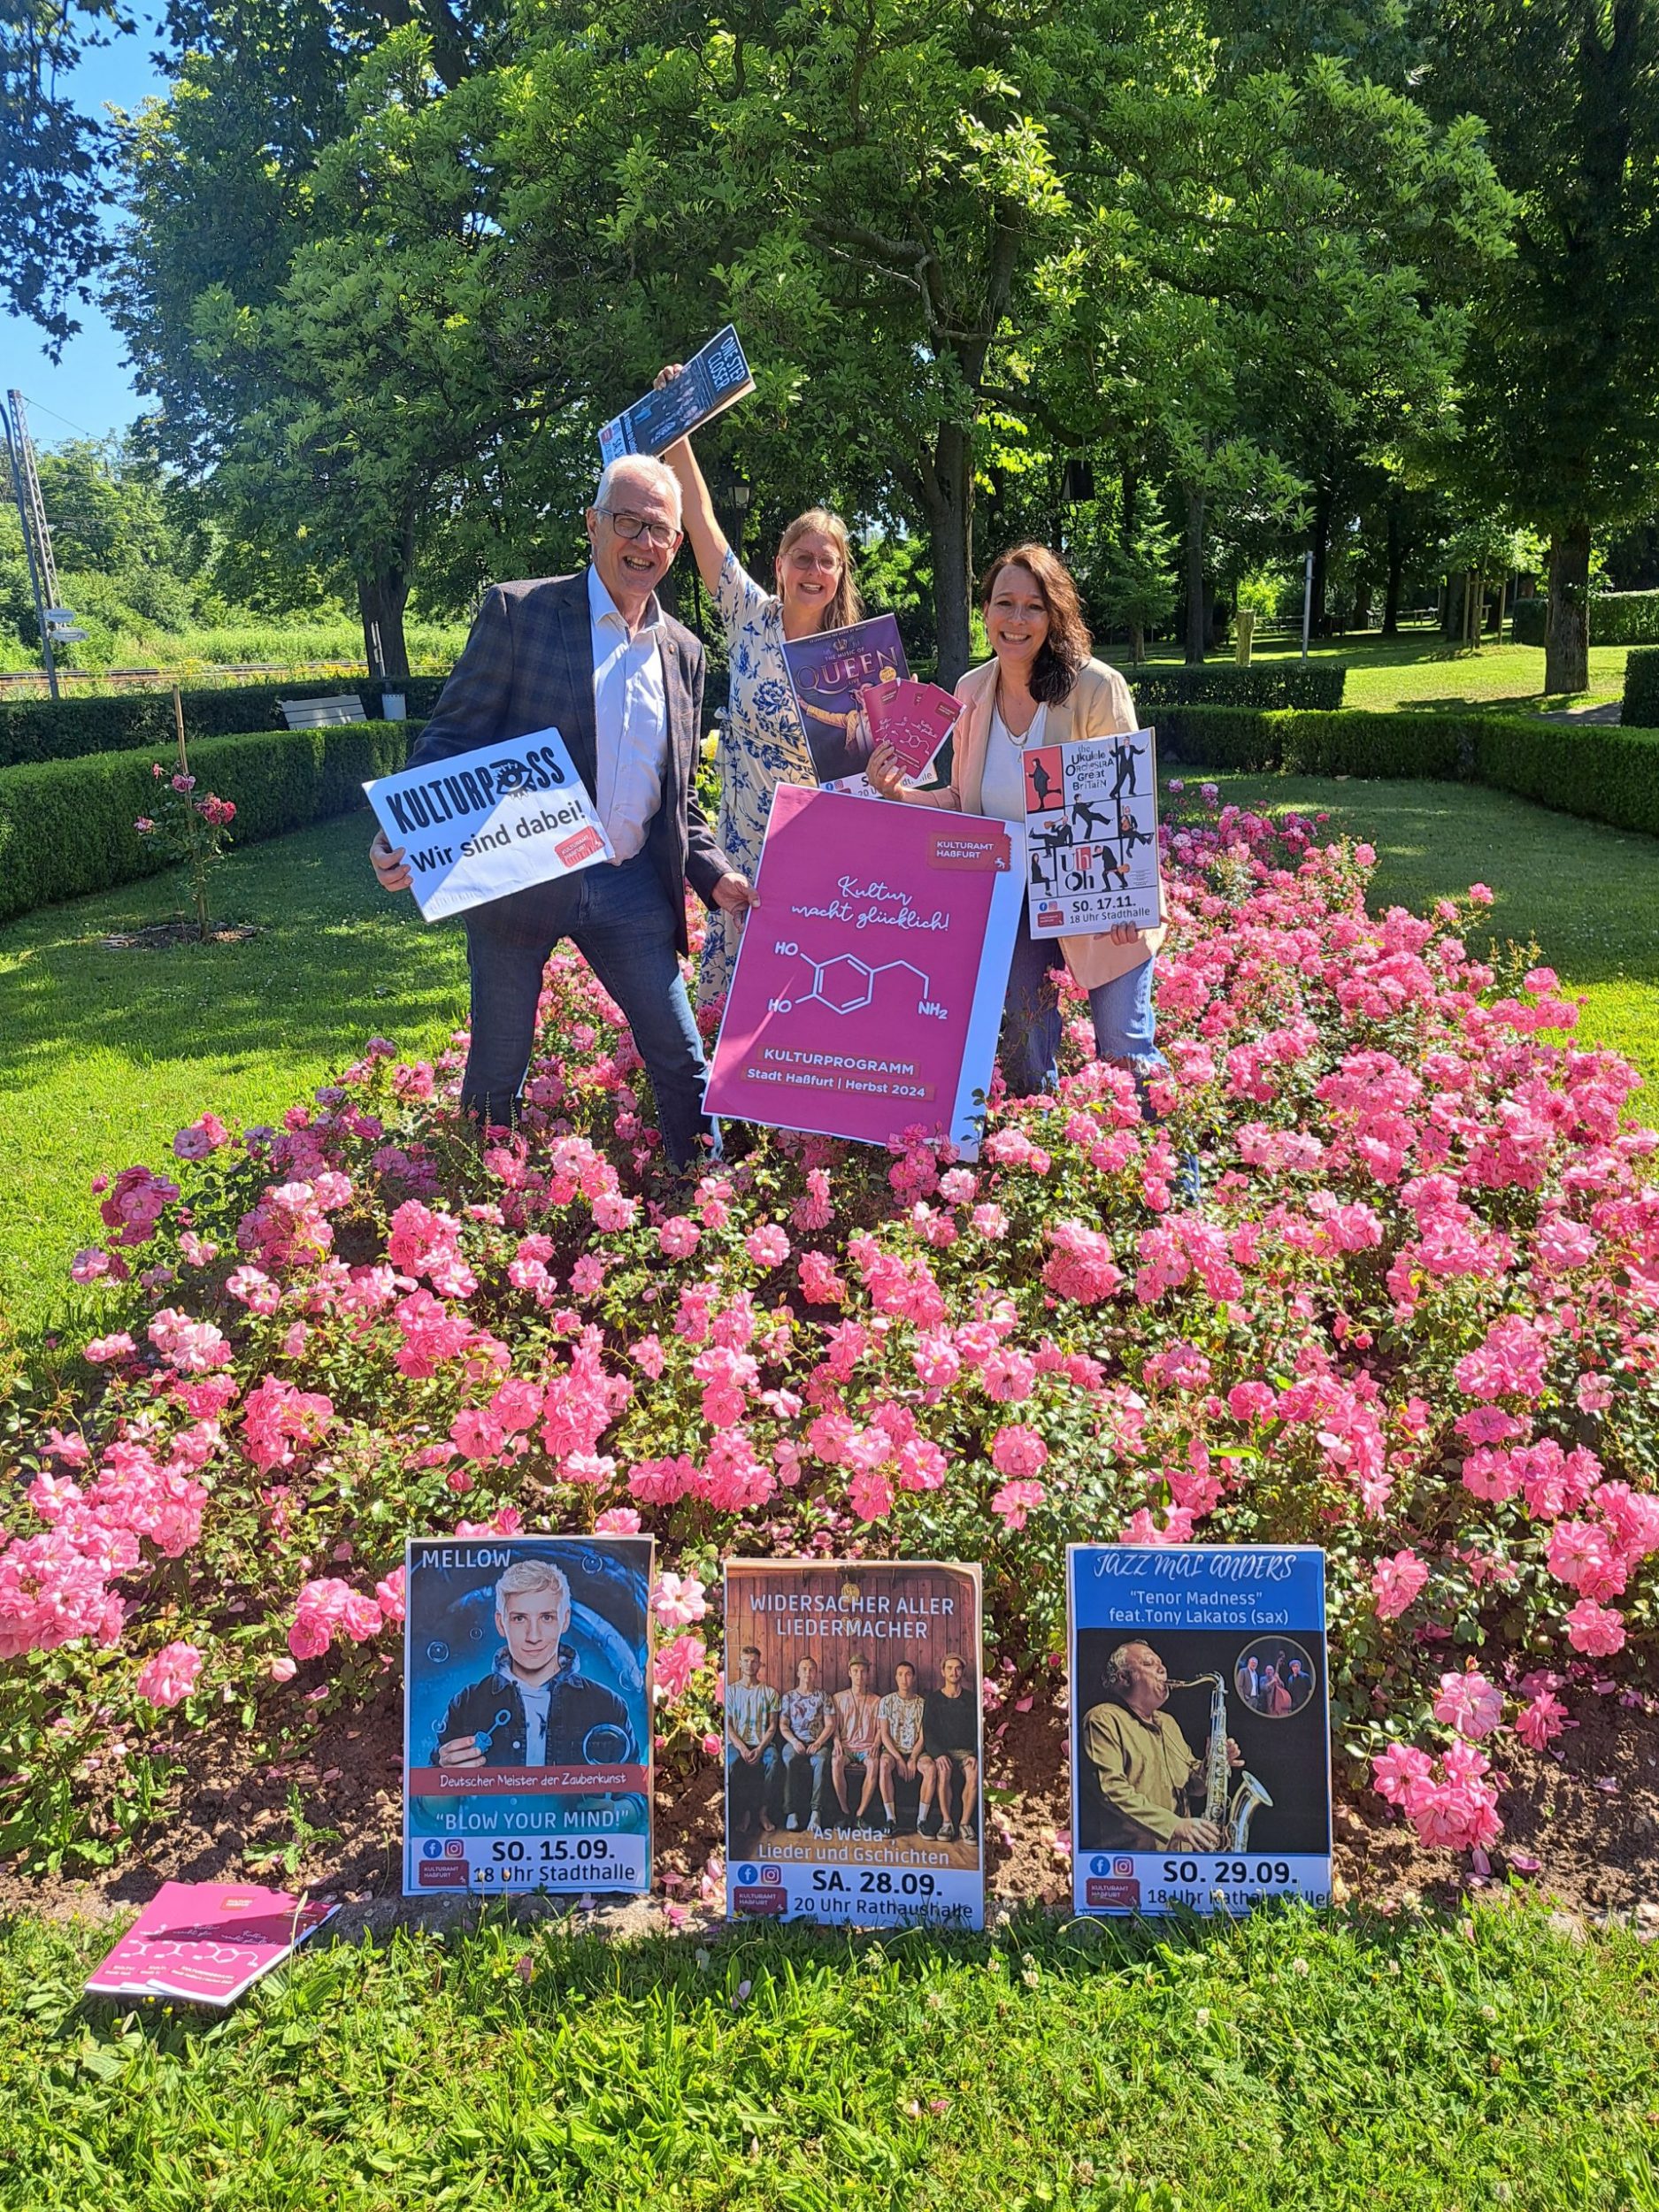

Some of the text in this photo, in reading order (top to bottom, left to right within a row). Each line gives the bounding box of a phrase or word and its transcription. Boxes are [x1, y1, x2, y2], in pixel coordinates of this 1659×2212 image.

[720, 336, 745, 381] ONE STEP
[708, 351, 730, 392] CLOSER
[837, 649, 855, 658] MUSIC
[797, 646, 898, 695] QUEEN
[1078, 770, 1105, 782] Great
[410, 799, 586, 872] Wir sind dabei!
[936, 841, 995, 850] KULTURAMT
[1060, 848, 1091, 872] Uh
[837, 875, 913, 906] Kultur
[1065, 869, 1094, 892] Oh
[1072, 895, 1136, 912] SO. 17.11.
[791, 900, 950, 932] macht glücklich!
[1070, 915, 1079, 924] 18
[1083, 912, 1099, 922] Uhr
[1102, 908, 1150, 920] Stadthalle
[775, 941, 798, 956] HO
[768, 998, 793, 1013] HO
[764, 1048, 915, 1075] KULTURPROGRAMM
[747, 1068, 782, 1081] Stadt
[786, 1071, 834, 1088] Haßfurt
[845, 1079, 888, 1094] Herbst
[891, 1085, 926, 1097] 2024
[421, 1548, 511, 1569] MELLOW
[1094, 1552, 1152, 1578] JAZZ
[1154, 1554, 1205, 1580] MAL
[750, 1594, 954, 1616] WIDERSACHER ALLER
[777, 1617, 928, 1639] LIEDERMACHER
[1186, 1609, 1247, 1624] Lakatos
[1251, 1609, 1288, 1625] (sax)
[440, 1772, 626, 1788] Deutscher Meister der Zauberkunst
[503, 1814, 557, 1830] YOUR
[492, 1839, 616, 1862] SO. 15.09.
[758, 1844, 949, 1865] Lieder und Gschichten
[474, 1864, 635, 1883] 18 Uhr Stadthalle
[812, 1869, 943, 1896] SA. 28.09.
[1163, 1861, 1298, 1884] SO. 29.09.
[794, 1897, 973, 1918] 20 Uhr Rathaushalle
[1148, 1890, 1166, 1903] 18
